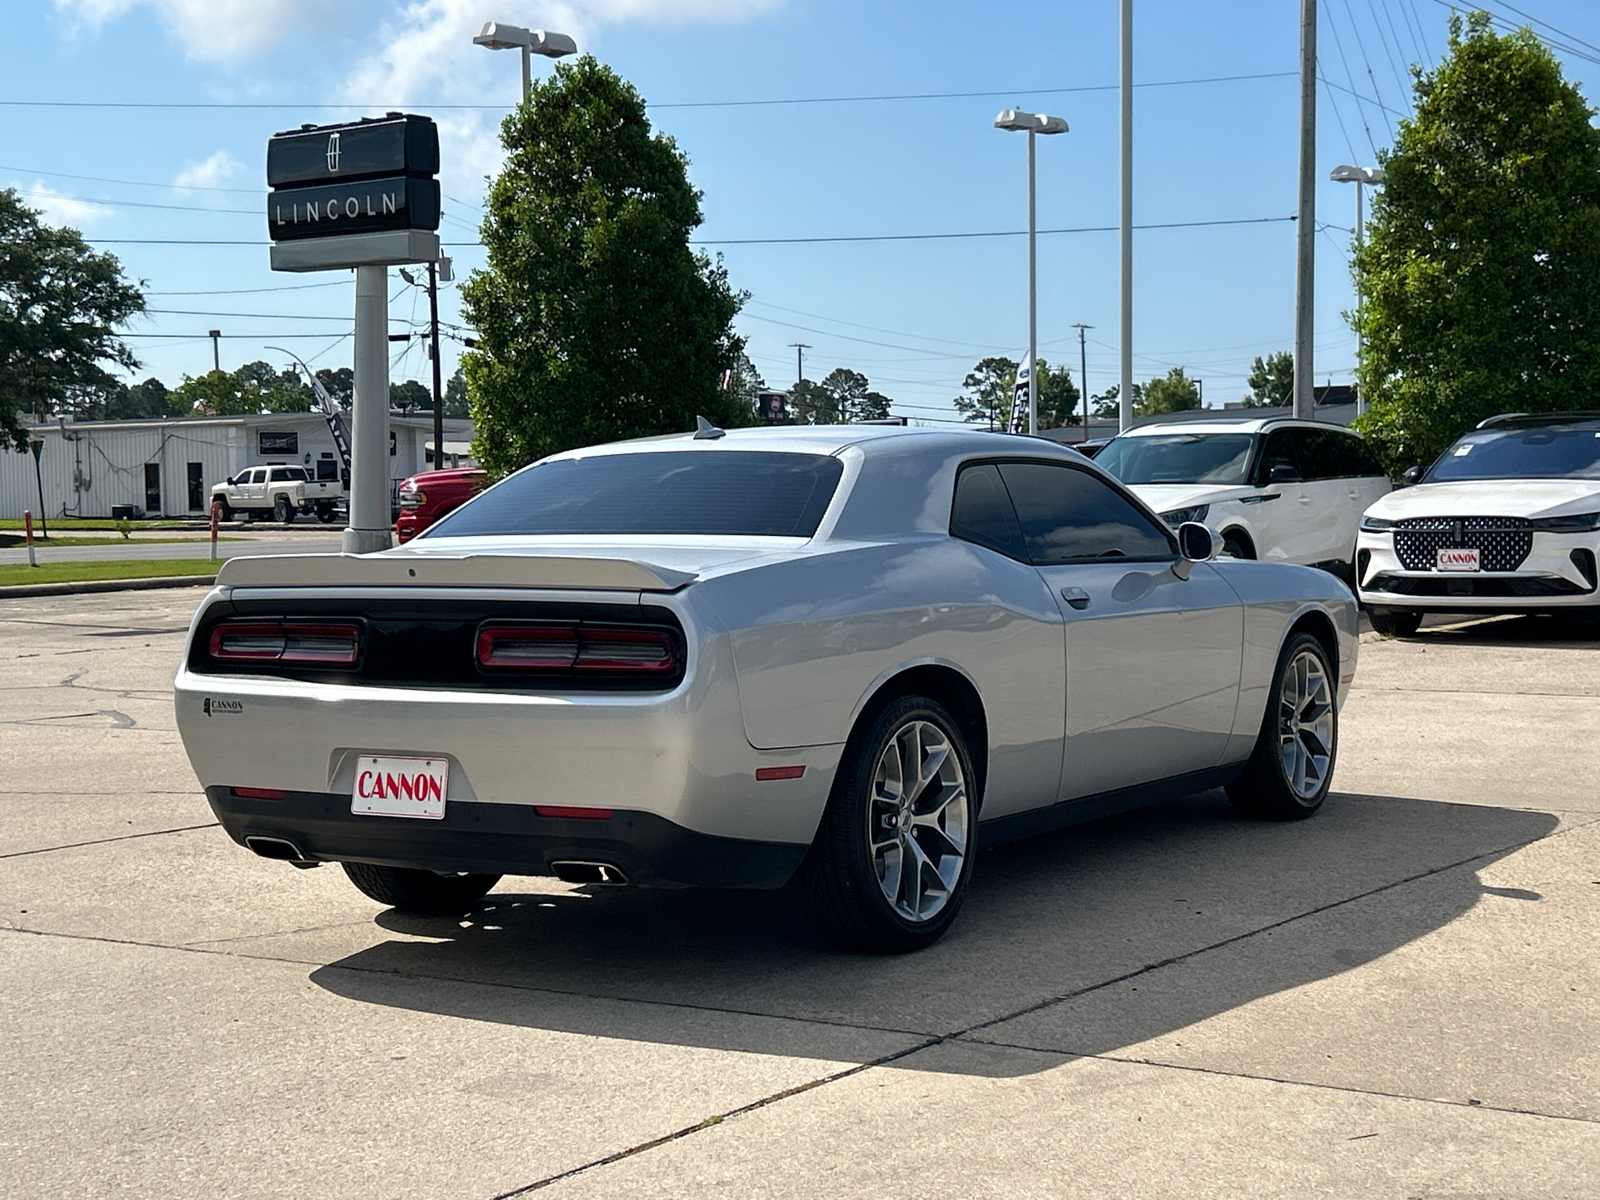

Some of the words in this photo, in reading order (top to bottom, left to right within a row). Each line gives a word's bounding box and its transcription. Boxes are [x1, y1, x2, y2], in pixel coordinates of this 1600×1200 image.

[276, 193, 396, 226] LINCOLN
[1440, 553, 1477, 563] CANNON
[211, 700, 243, 710] CANNON
[358, 770, 443, 802] CANNON
